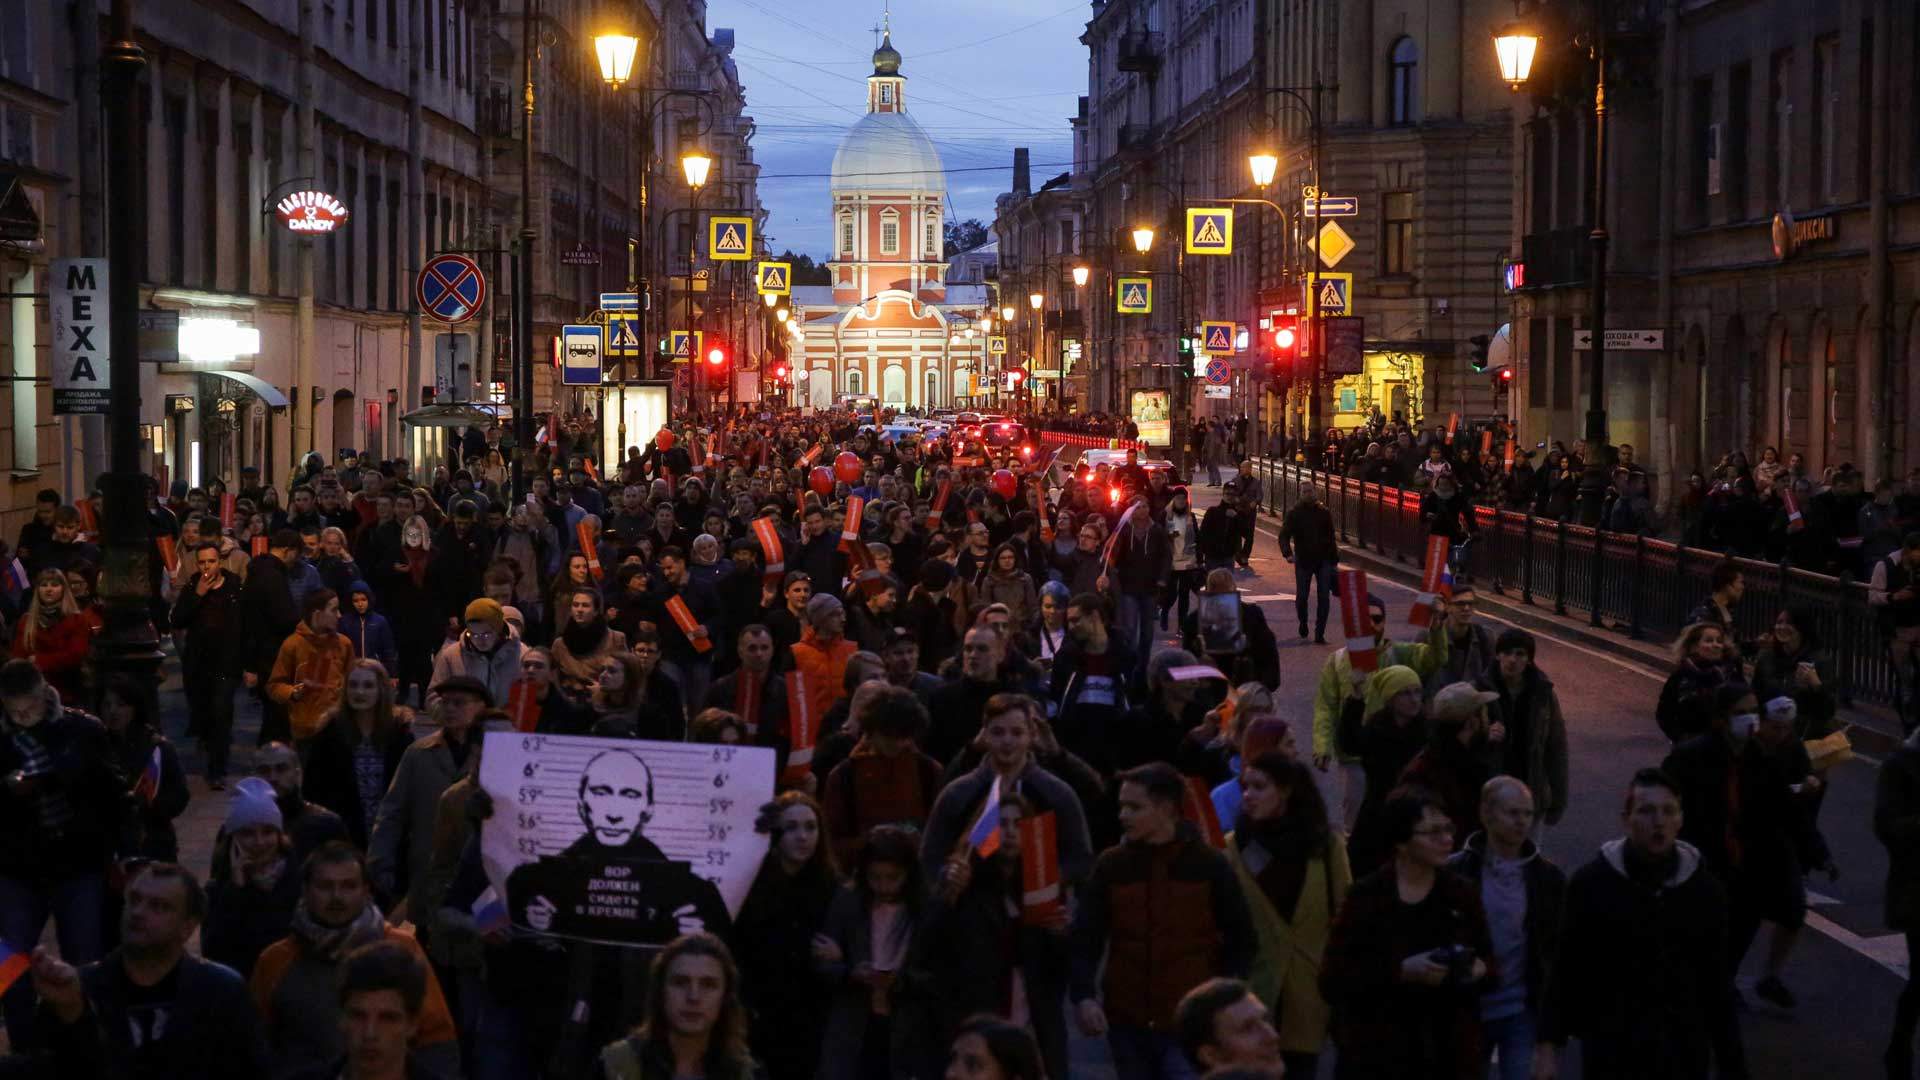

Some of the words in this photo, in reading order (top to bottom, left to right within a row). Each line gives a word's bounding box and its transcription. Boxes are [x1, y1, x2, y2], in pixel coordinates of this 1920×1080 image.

[277, 191, 345, 216] ГАСТРОБАР
[289, 218, 335, 231] DANDY
[66, 265, 96, 381] МЕХА
[1604, 332, 1640, 340] ОХОВАЯ
[603, 865, 632, 878] ВОР
[586, 878, 641, 892] ДОЛЖЕН
[587, 905, 640, 920] КРЕМЛЕ
